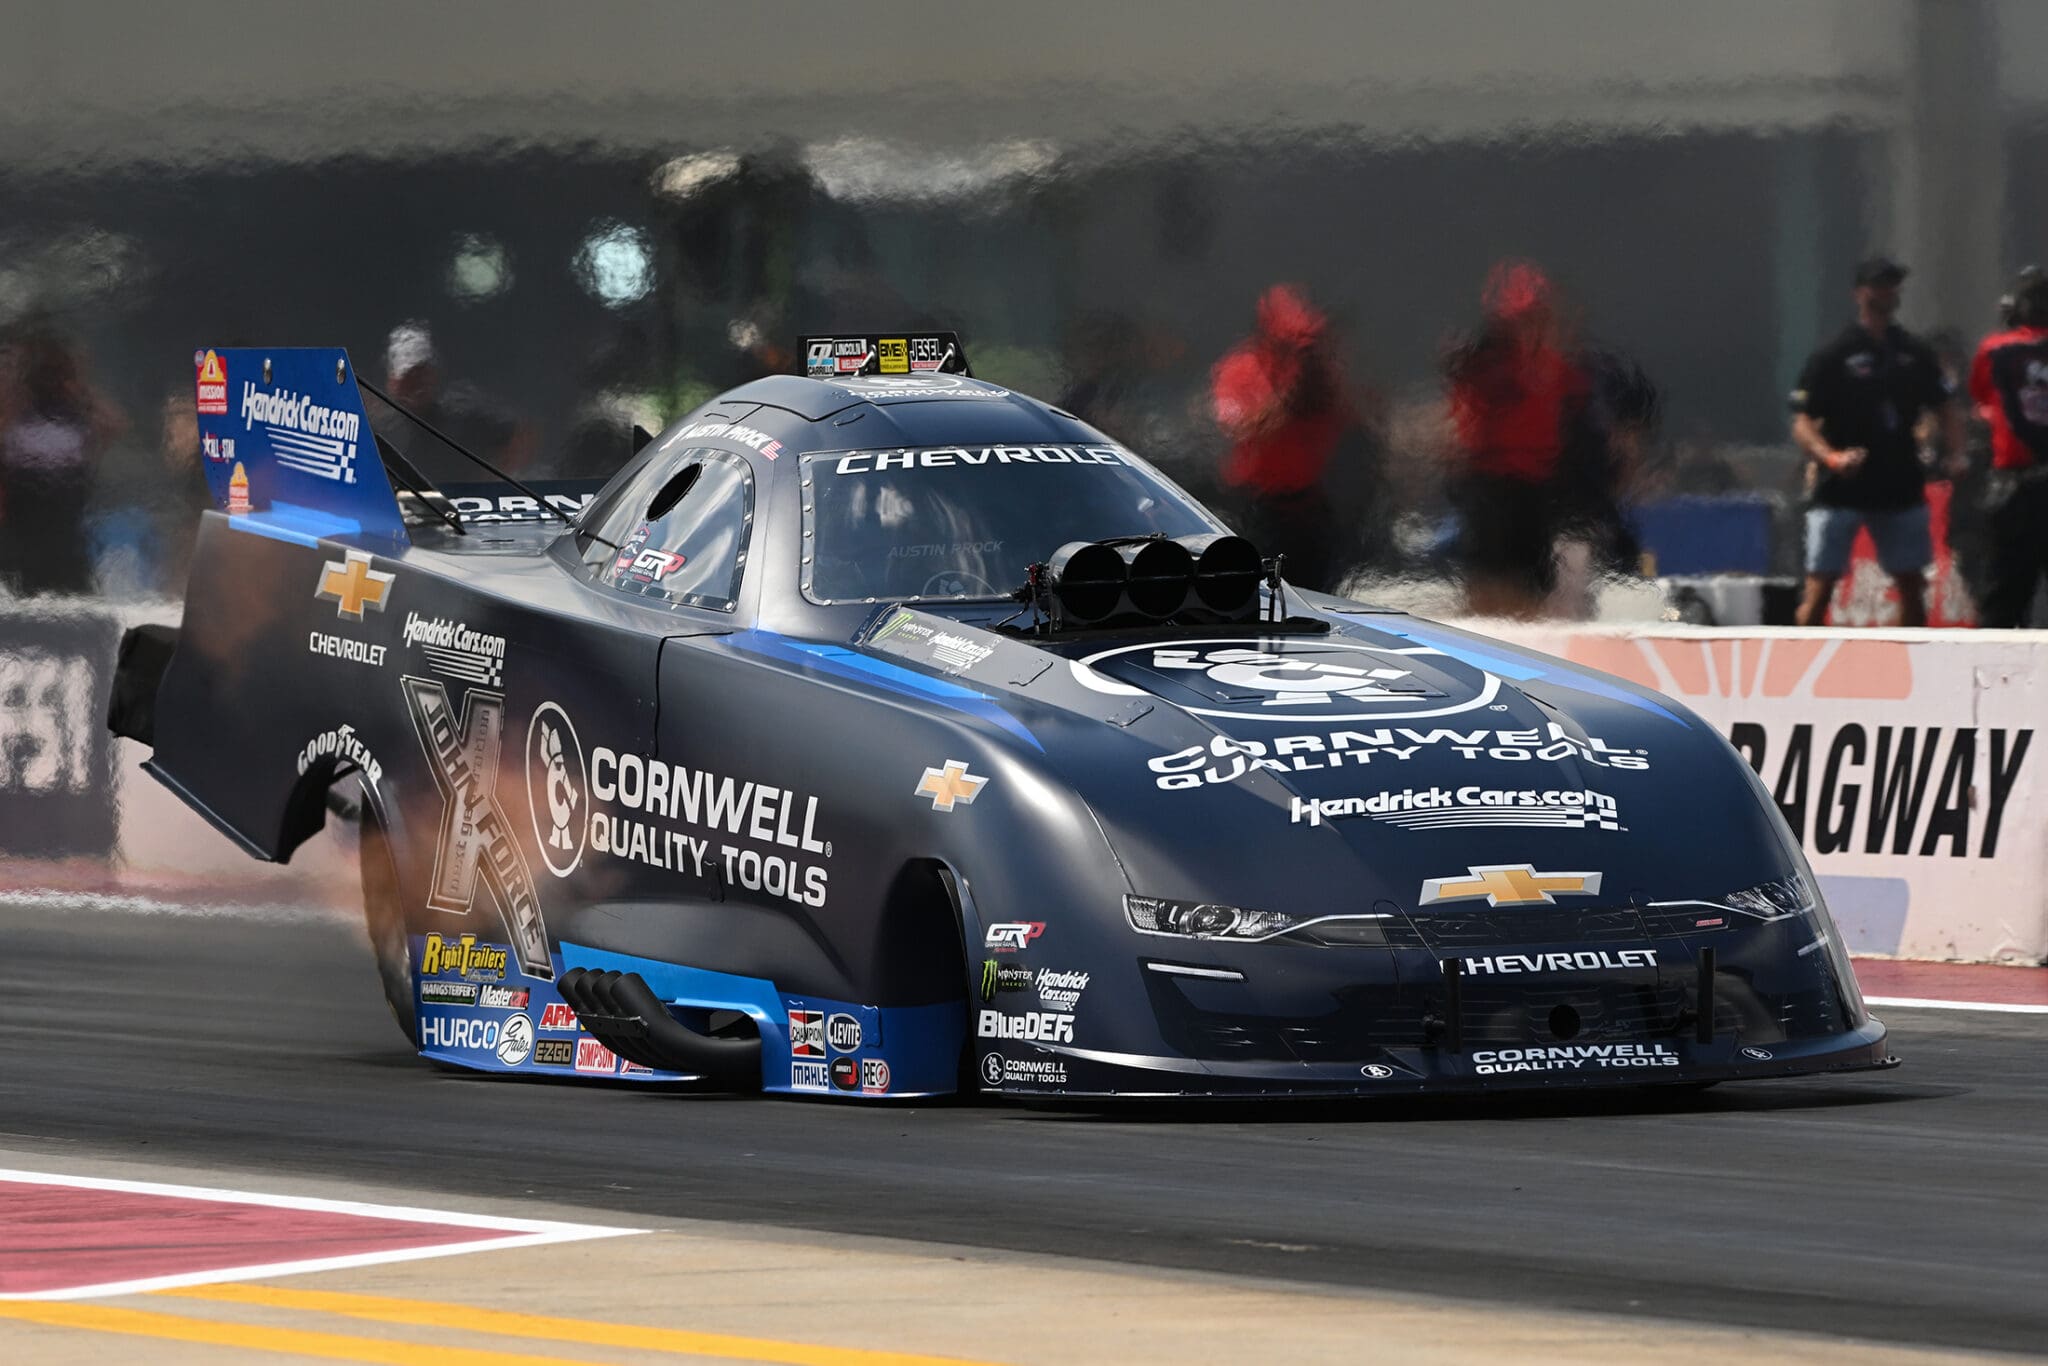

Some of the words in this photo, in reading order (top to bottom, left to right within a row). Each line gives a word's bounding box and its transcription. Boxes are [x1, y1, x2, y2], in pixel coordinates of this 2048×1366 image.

[835, 343, 861, 356] LINCOLN
[910, 338, 943, 361] JESEL
[888, 544, 946, 560] AUSTIN
[309, 632, 387, 667] CHEVROLET
[1148, 722, 1631, 773] CORNWELL
[1156, 746, 1422, 790] QUALITY
[1451, 741, 1650, 770] TOOLS
[591, 746, 825, 854] CORNWELL
[424, 702, 485, 811] JOHN
[475, 811, 540, 951] FORCE
[590, 812, 709, 878] QUALITY
[721, 845, 828, 908] TOOLS
[986, 921, 1046, 949] GRP
[998, 967, 1033, 981] MONSTER
[1034, 967, 1090, 991] Hendrick
[1040, 987, 1080, 1002] Cars.com
[541, 1004, 577, 1022] ARP
[421, 1017, 500, 1050] HURCO
[792, 1026, 823, 1043] CHAMPION
[978, 1010, 1075, 1043] BlueDEF
[578, 1043, 614, 1069] SIMPSON
[1472, 1044, 1672, 1065] CORNWELL
[1475, 1059, 1585, 1075] QUALITY
[1597, 1057, 1680, 1068] TOOLS
[793, 1065, 828, 1088] MAHLE
[1005, 1060, 1066, 1073] CORNWELL
[1005, 1072, 1035, 1082] QUALITY
[1038, 1074, 1067, 1083] TOOLS
